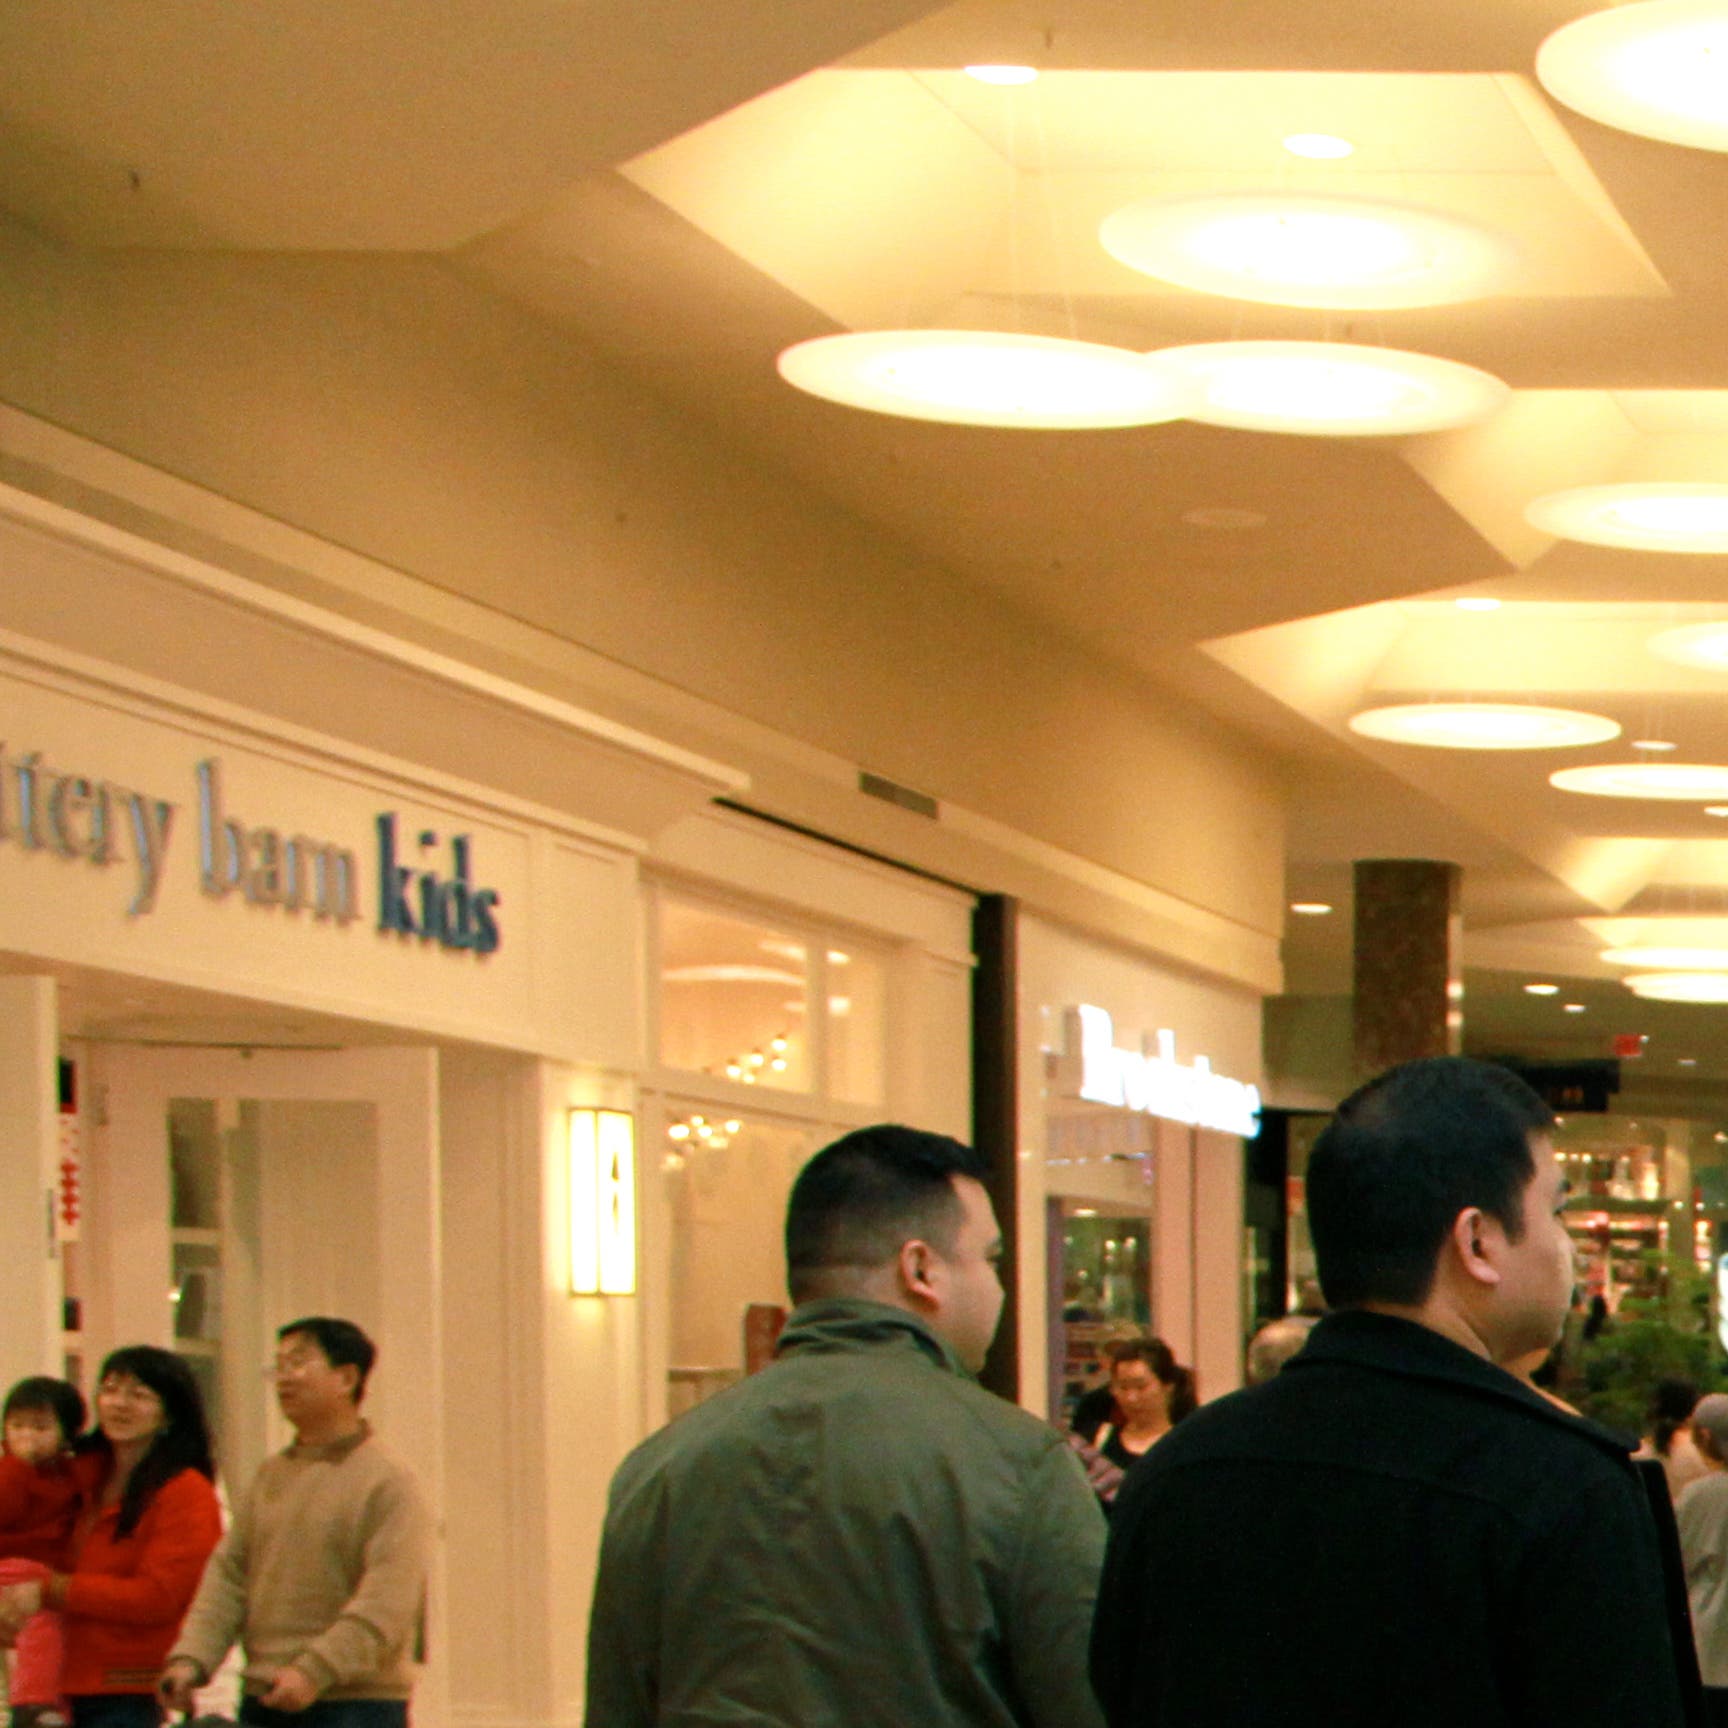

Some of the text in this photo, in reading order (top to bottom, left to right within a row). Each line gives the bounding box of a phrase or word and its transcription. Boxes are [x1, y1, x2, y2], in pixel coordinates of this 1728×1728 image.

[0, 742, 501, 957] tery barn kids
